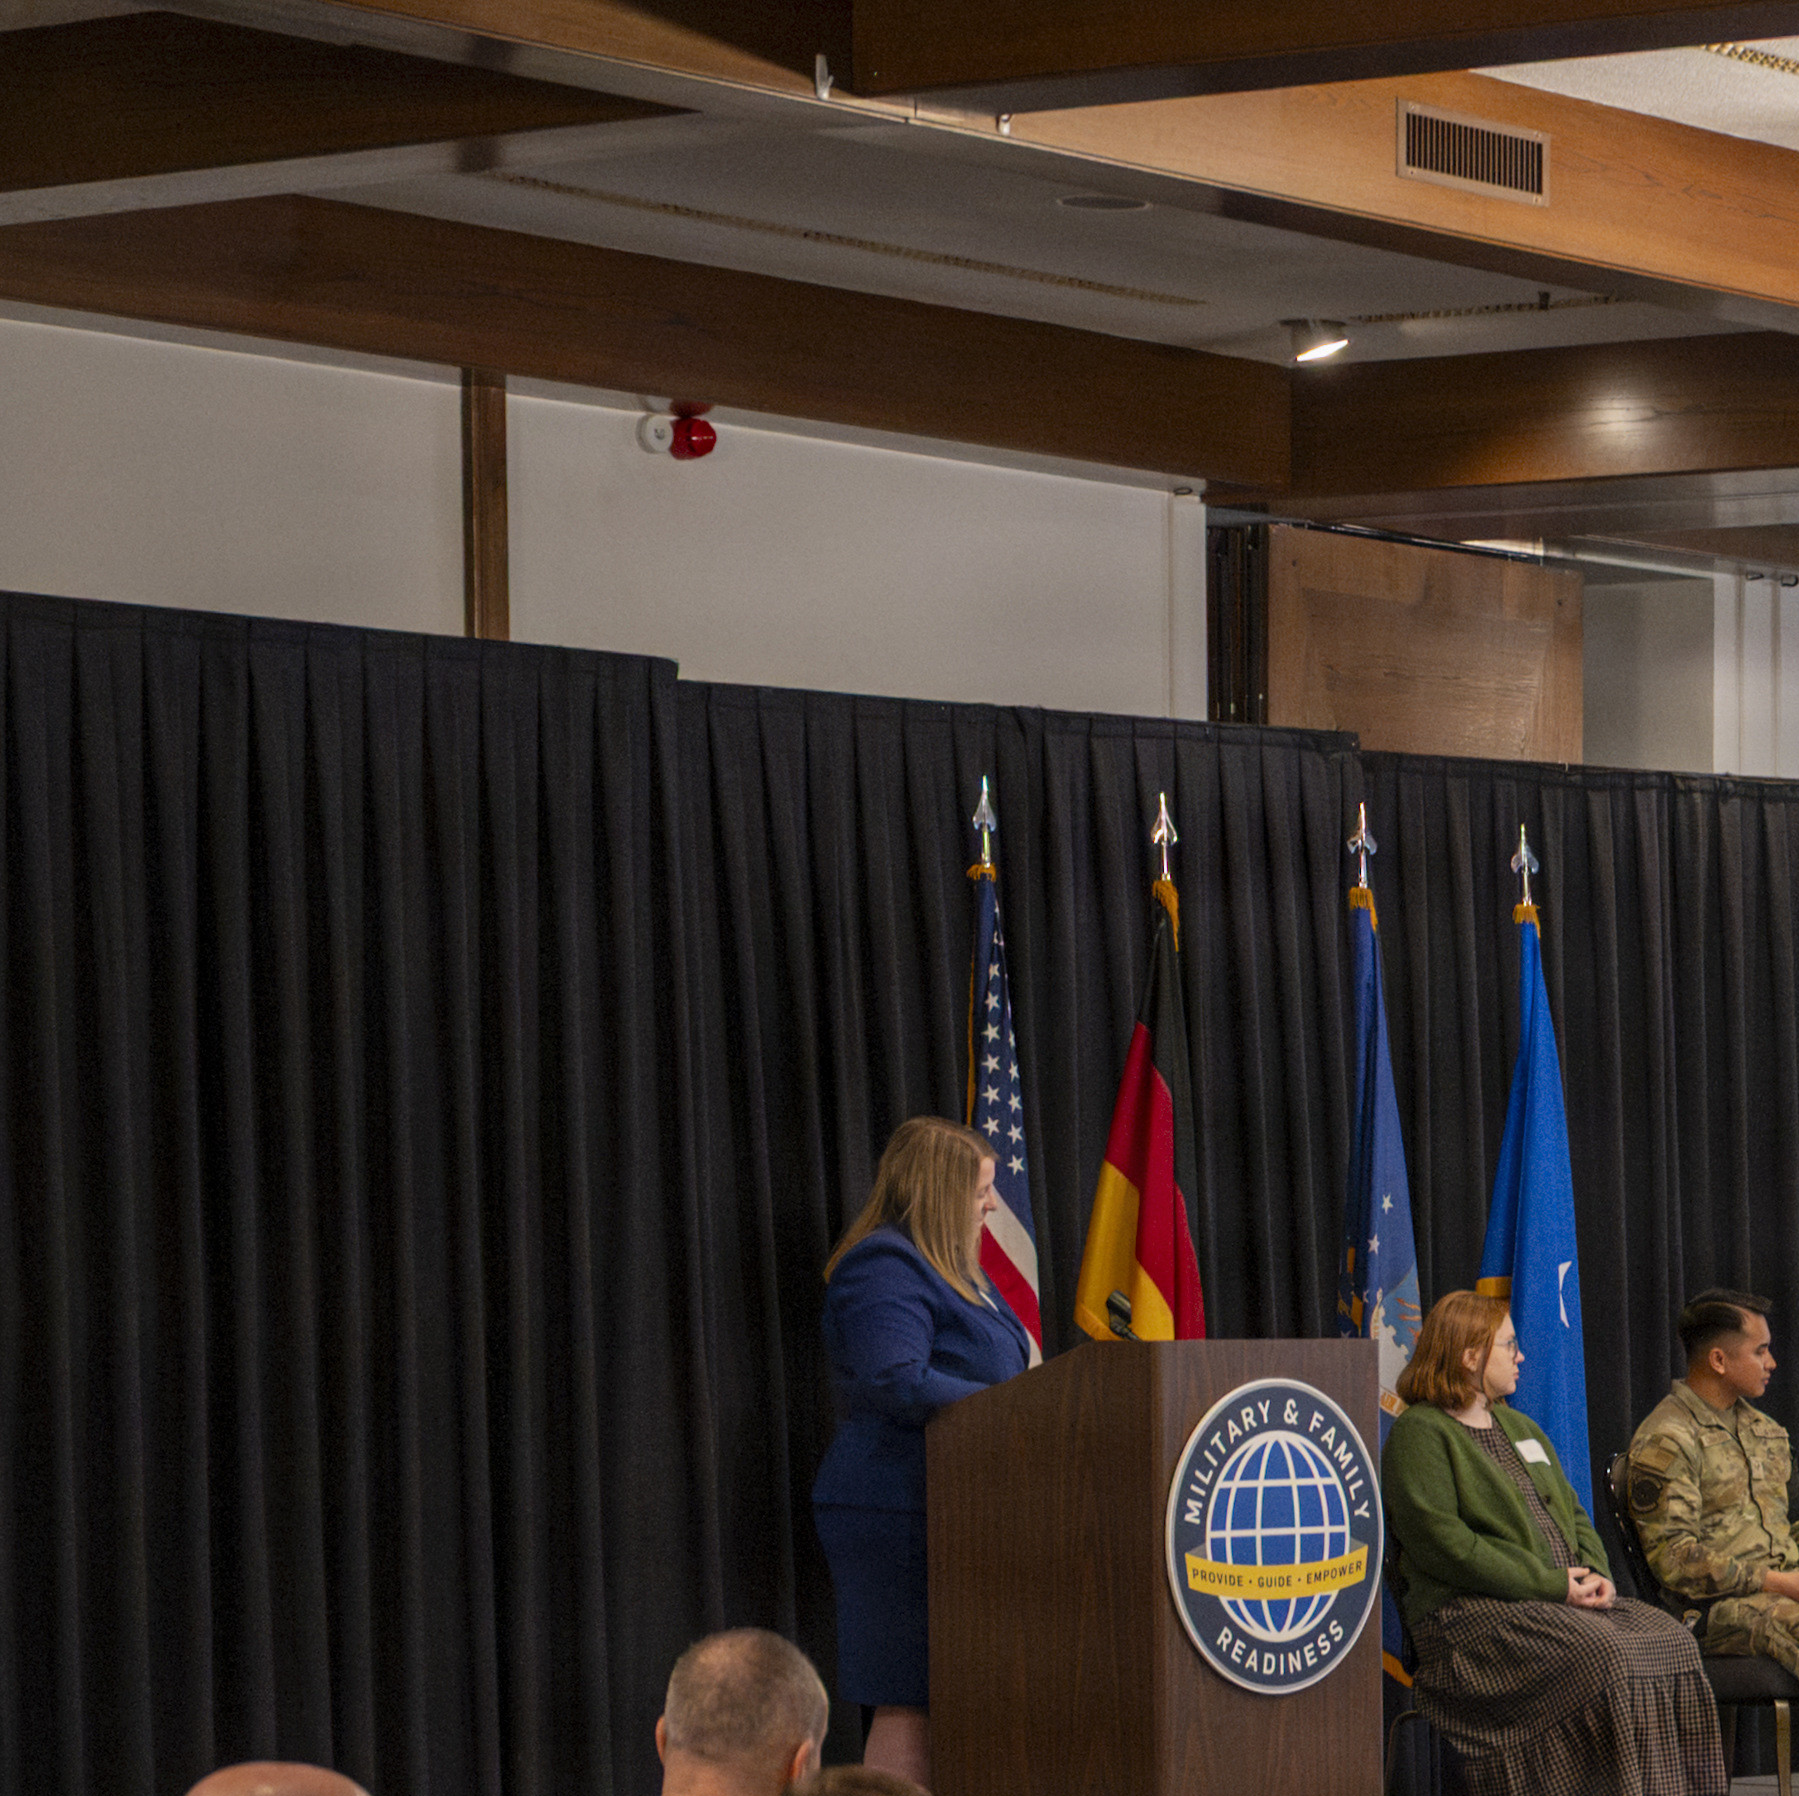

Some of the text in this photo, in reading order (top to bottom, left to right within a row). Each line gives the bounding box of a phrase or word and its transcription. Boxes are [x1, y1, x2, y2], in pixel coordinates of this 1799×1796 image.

[1184, 1398, 1371, 1525] MILITARY & FAMILY
[1192, 1560, 1363, 1588] PROVIDE GUIDE EMPOWER
[1216, 1619, 1344, 1676] READINESS
